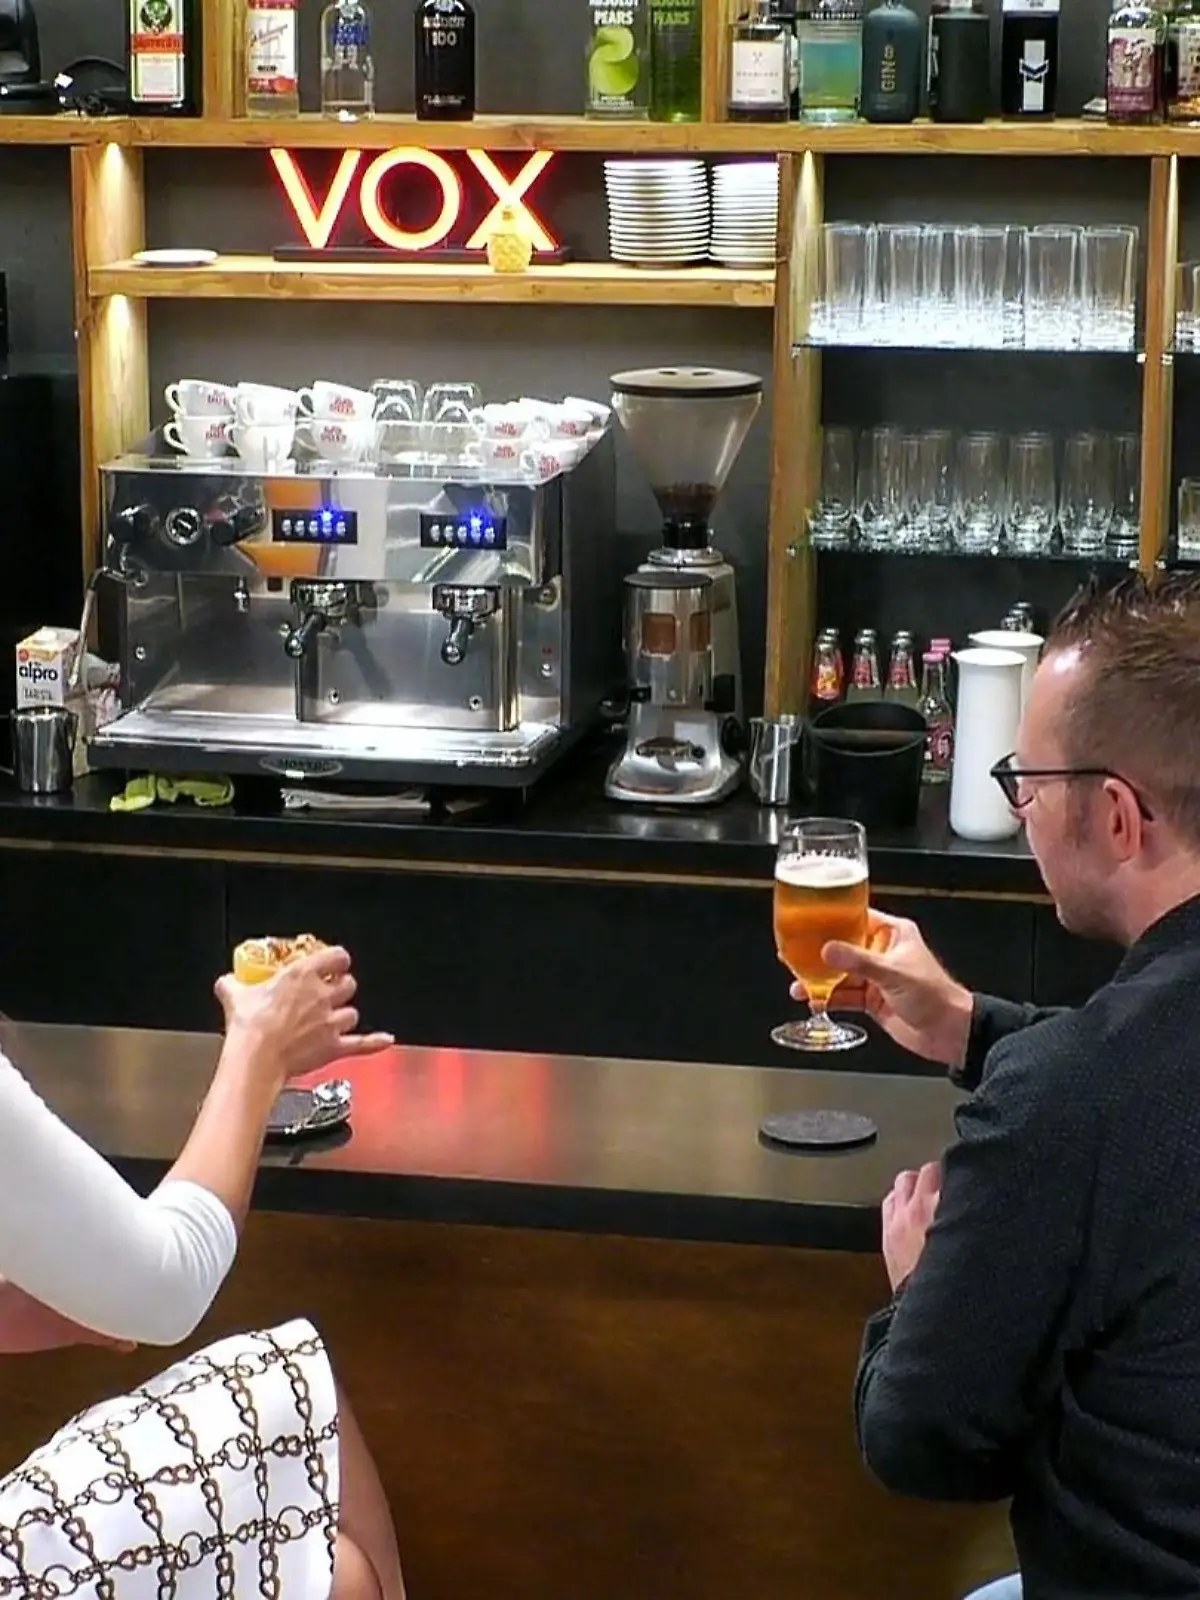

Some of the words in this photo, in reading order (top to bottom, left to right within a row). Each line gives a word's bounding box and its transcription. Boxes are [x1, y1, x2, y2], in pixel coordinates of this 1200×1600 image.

[594, 10, 633, 25] PEARS
[432, 31, 457, 46] 100
[269, 146, 560, 251] VOX
[19, 662, 58, 683] alpro
